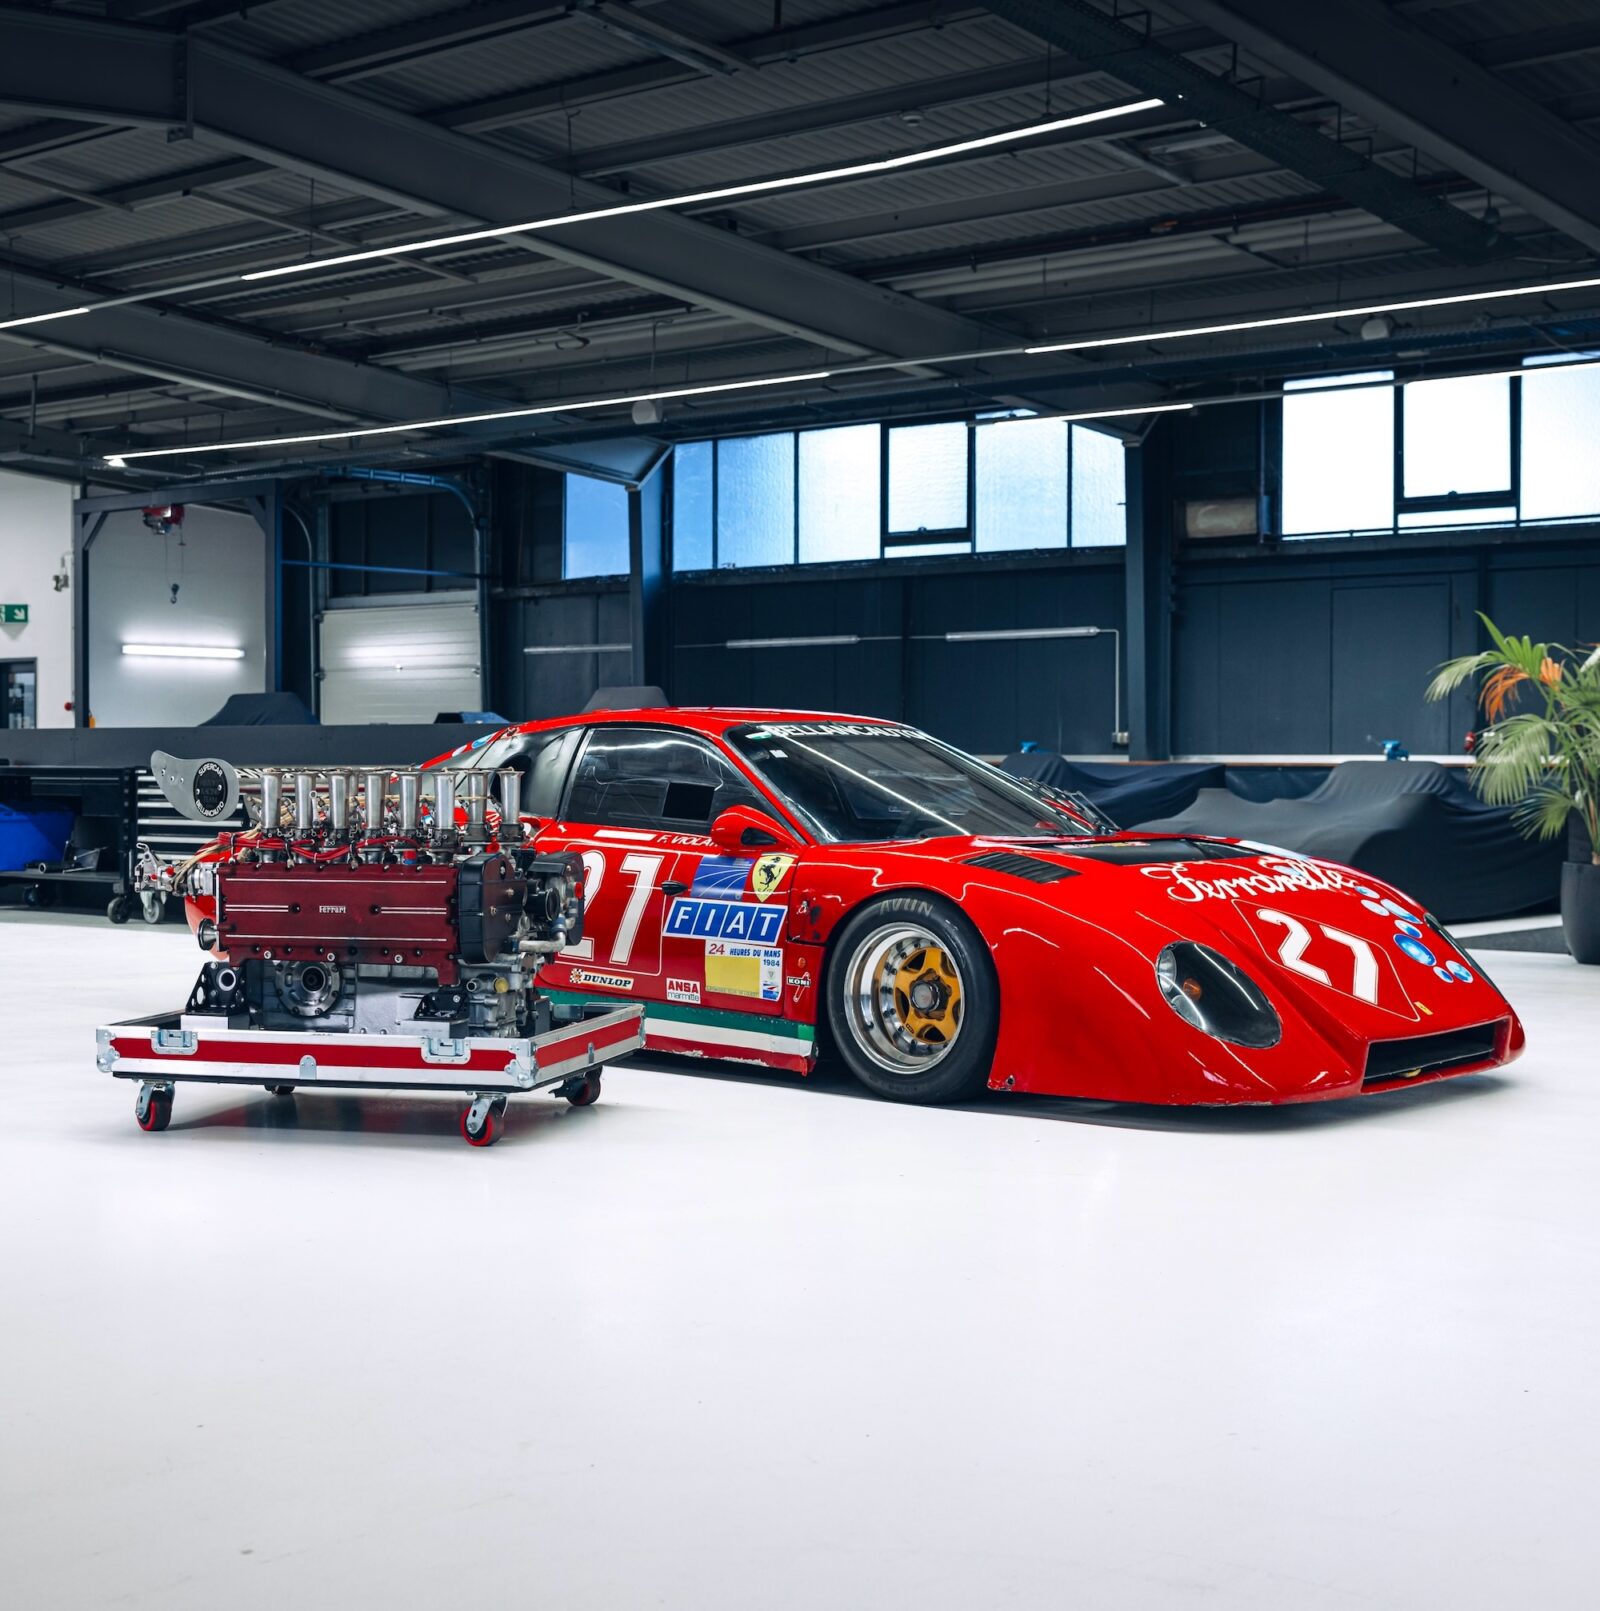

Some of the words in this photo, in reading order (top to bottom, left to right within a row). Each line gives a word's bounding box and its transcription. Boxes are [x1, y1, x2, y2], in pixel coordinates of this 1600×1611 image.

[198, 763, 223, 777] SUPERCAR
[656, 834, 672, 844] F.
[671, 835, 719, 848] VIOLA
[319, 905, 347, 914] Ferrari
[880, 898, 934, 917] AVON
[674, 906, 779, 937] FIAT
[708, 943, 725, 955] 24
[729, 948, 751, 957] HEURES
[753, 949, 762, 957] DU
[763, 949, 781, 958] MANS
[1256, 908, 1379, 1005] 27
[763, 959, 780, 967] 1984
[583, 974, 632, 988] DUNLOP
[668, 980, 699, 994] ANSA
[788, 978, 810, 986] KONI
[668, 991, 700, 1002] marmitte
